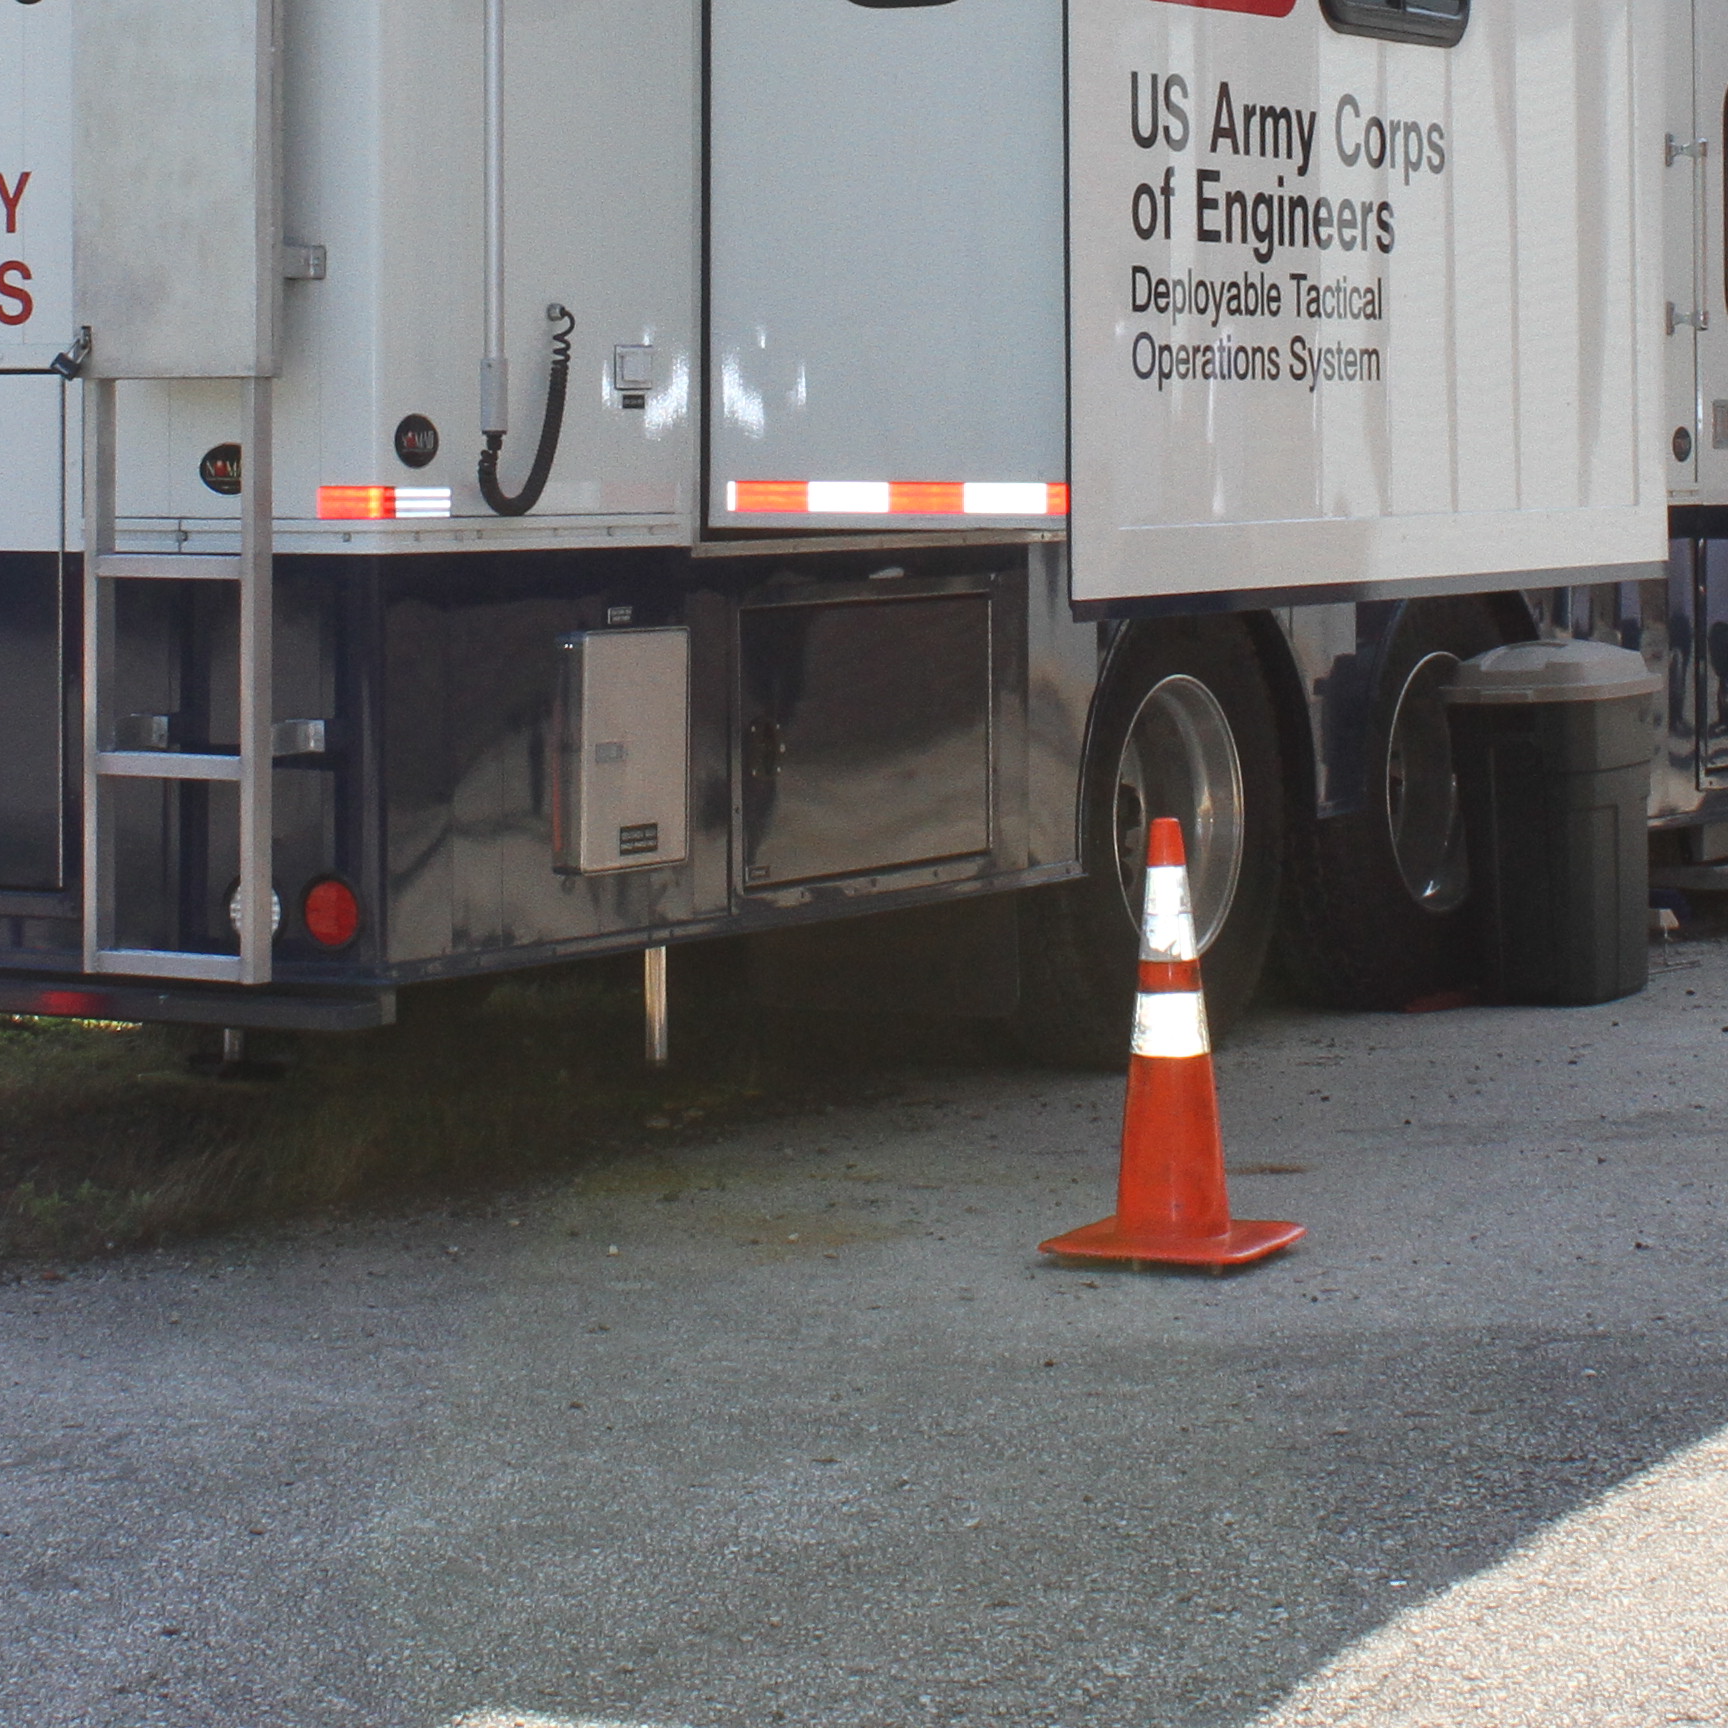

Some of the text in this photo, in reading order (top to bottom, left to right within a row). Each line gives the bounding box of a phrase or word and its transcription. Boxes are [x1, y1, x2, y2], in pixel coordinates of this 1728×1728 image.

[1131, 71, 1445, 186] US Army Corps
[1131, 165, 1395, 264] of Engineers
[1131, 265, 1383, 328] Deployable Tactical
[1132, 331, 1381, 393] Operations System
